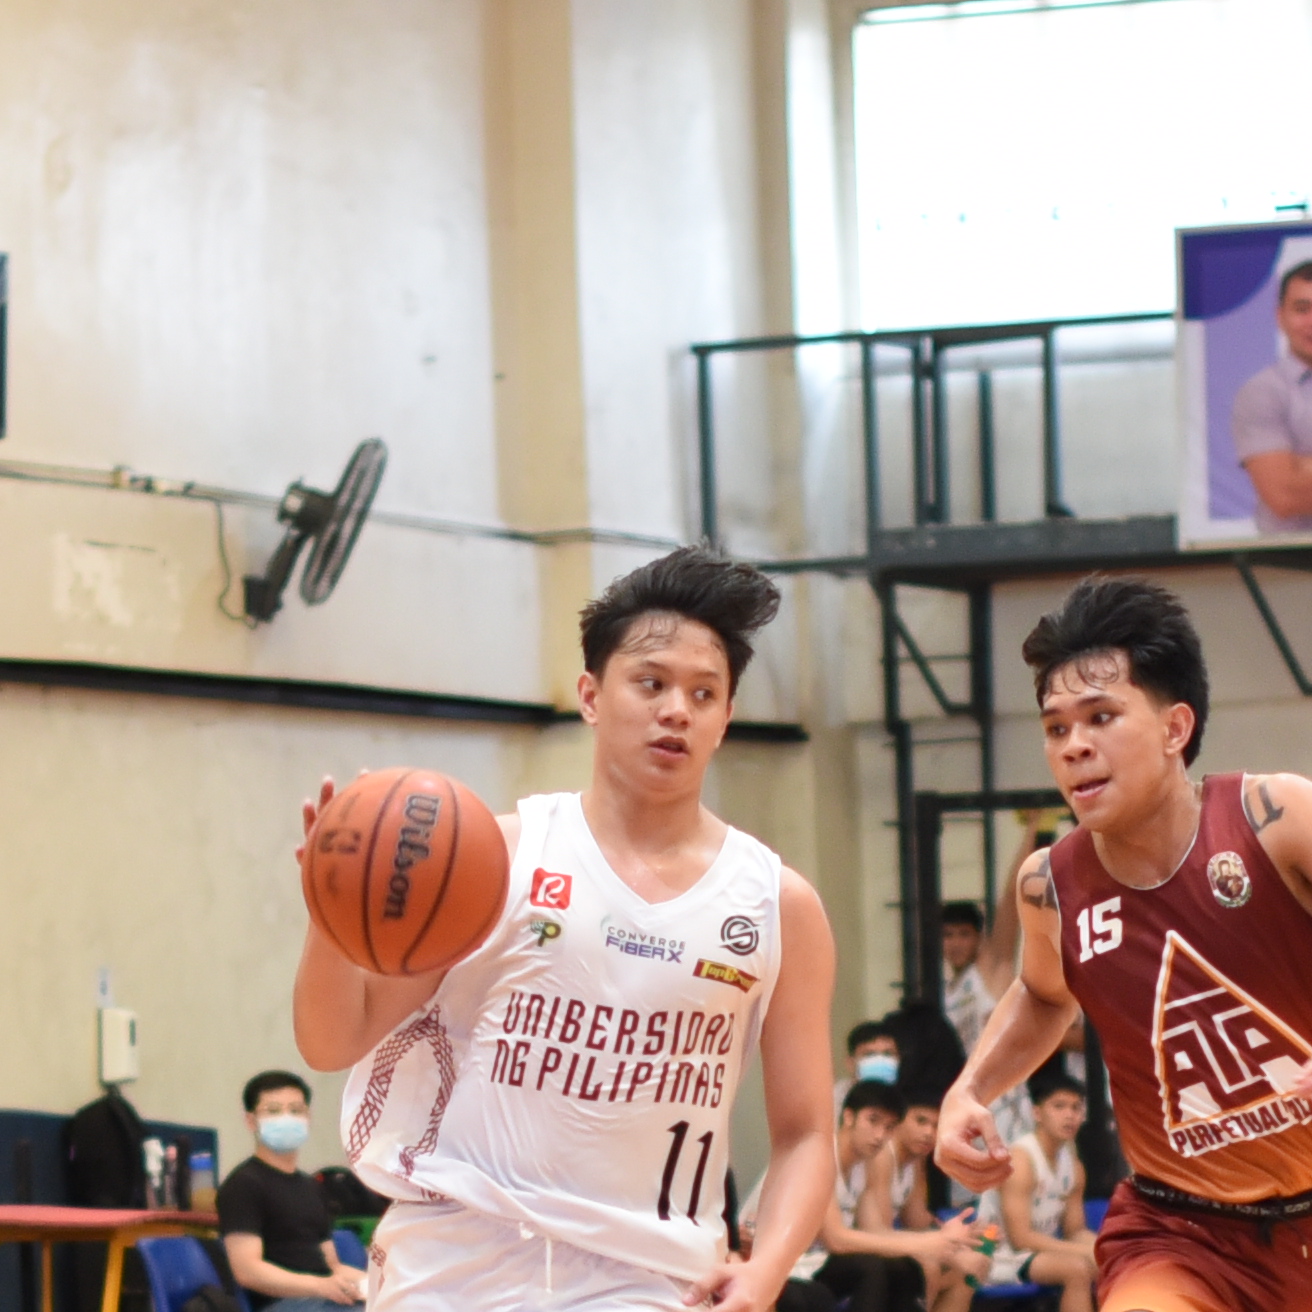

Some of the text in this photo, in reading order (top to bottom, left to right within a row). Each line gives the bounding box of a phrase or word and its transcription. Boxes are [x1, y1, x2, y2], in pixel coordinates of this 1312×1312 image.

[382, 795, 441, 920] Wilson
[607, 925, 686, 951] CONVERGE
[1077, 897, 1123, 963] 15
[491, 1039, 725, 1109] NG PILIPINAS
[1170, 1101, 1289, 1154] PERPETUAL
[657, 1120, 714, 1227] 11
